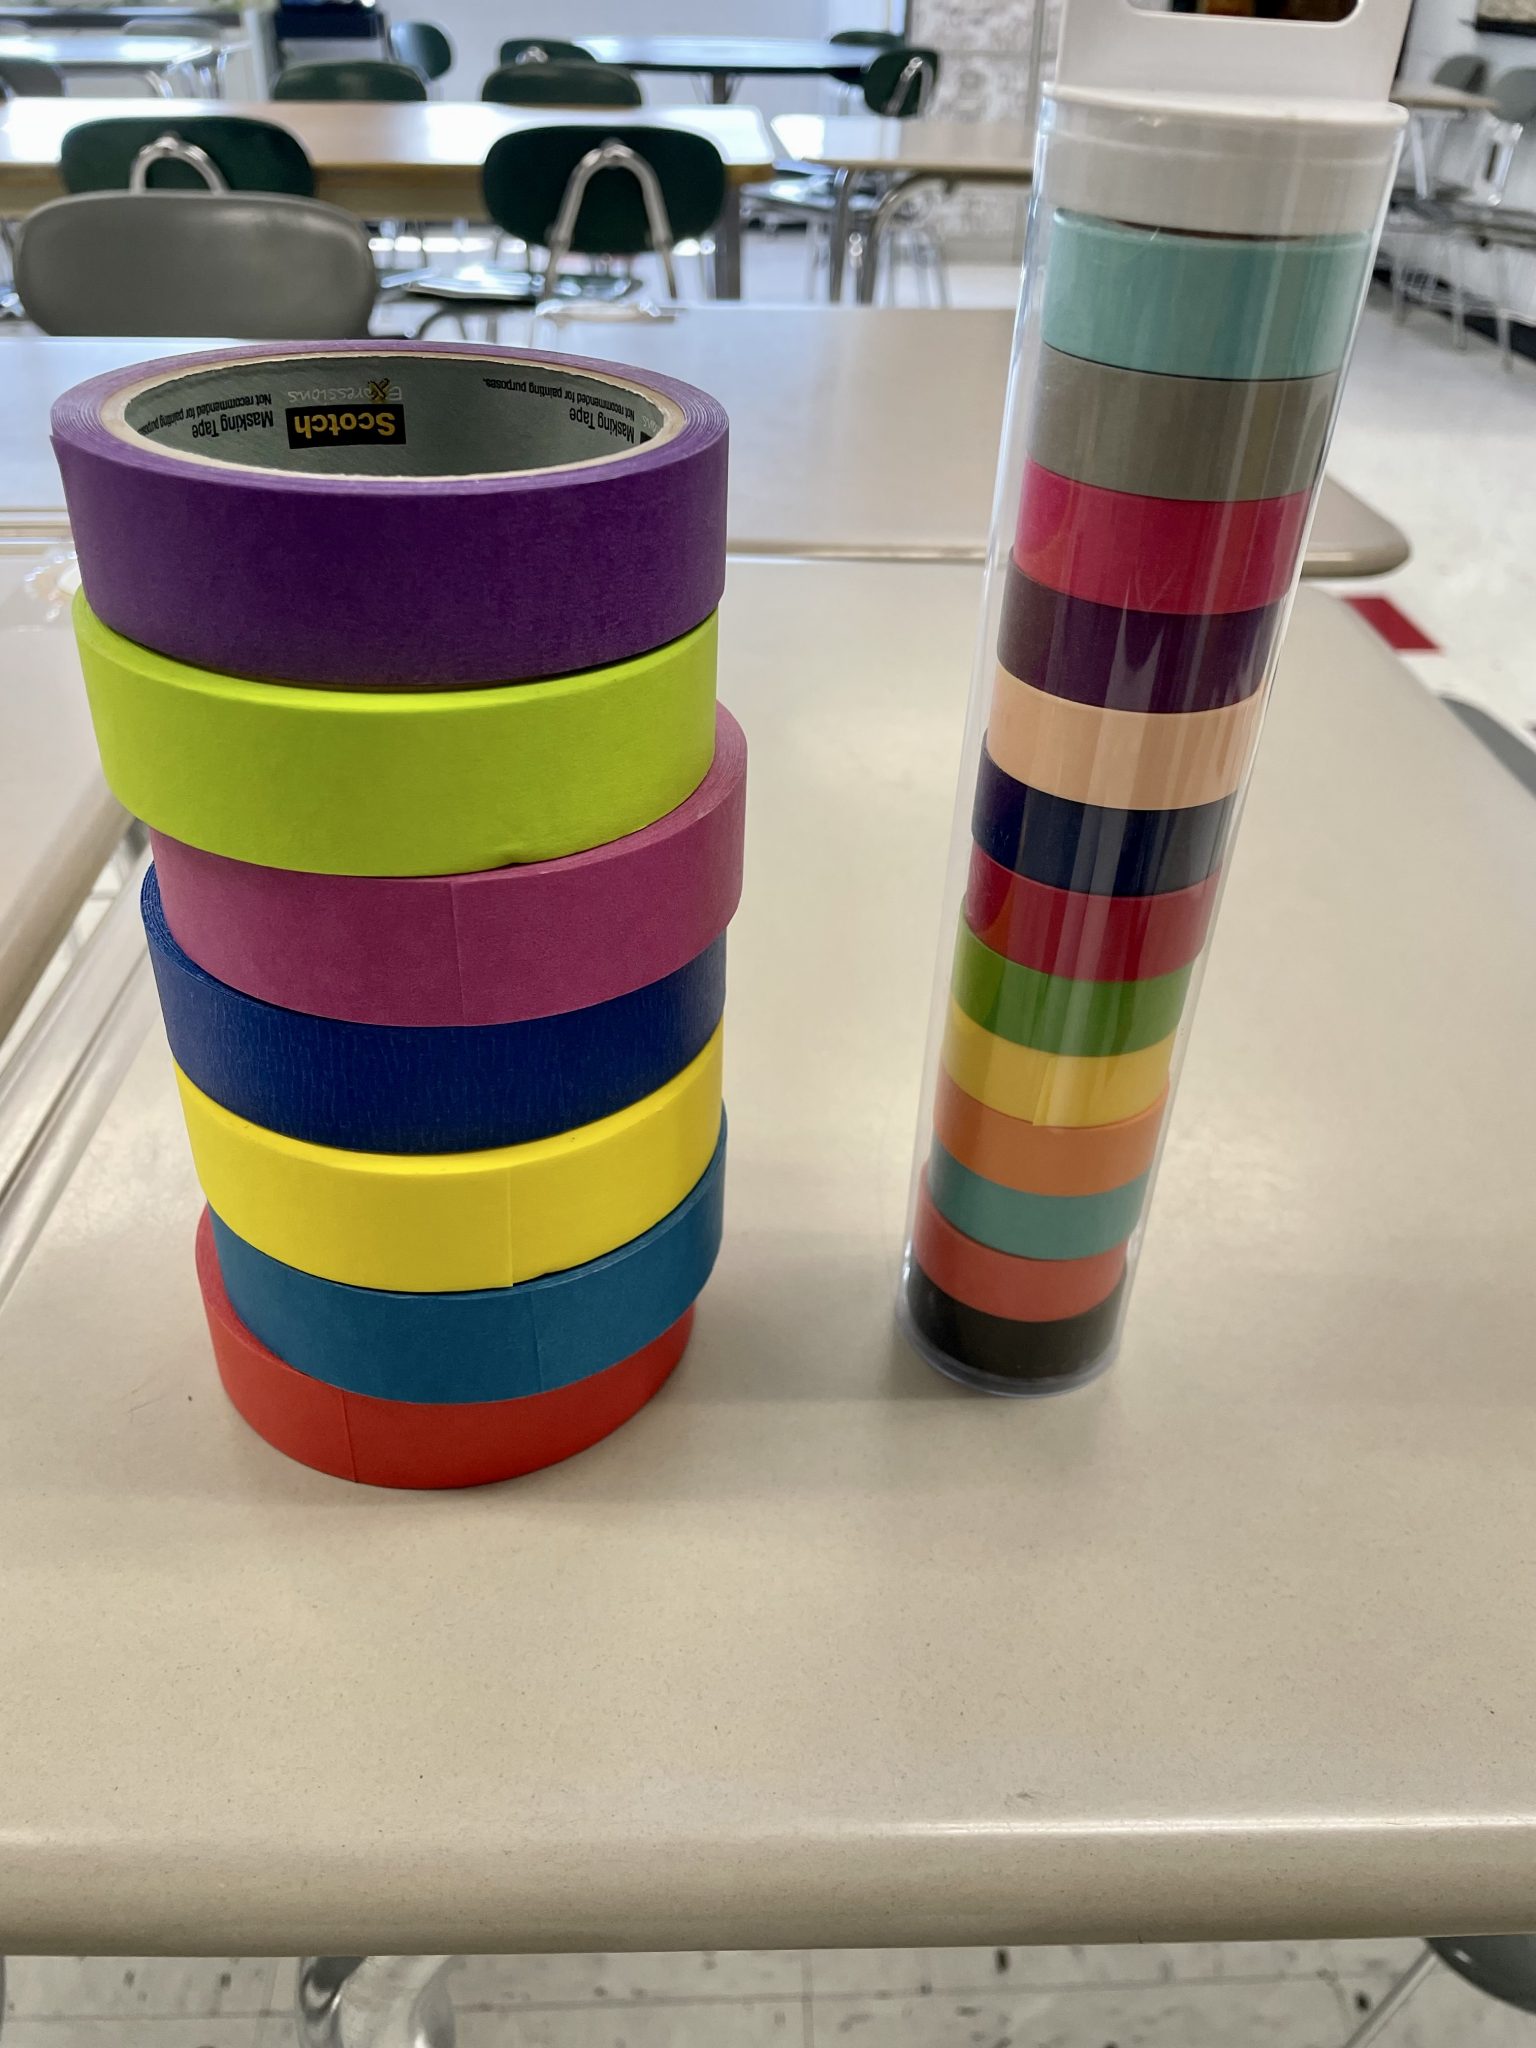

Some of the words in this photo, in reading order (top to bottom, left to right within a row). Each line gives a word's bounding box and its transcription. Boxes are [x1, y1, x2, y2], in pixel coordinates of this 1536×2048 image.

[482, 378, 527, 393] purposes.
[528, 382, 562, 399] painting
[196, 395, 254, 418] recommended
[256, 393, 272, 406] Not
[564, 390, 575, 404] for
[576, 393, 624, 416] recommended
[186, 407, 196, 420] for
[221, 410, 274, 432] Masking
[569, 407, 596, 430] Tape
[625, 406, 635, 422] Not
[191, 418, 219, 438] Tape
[293, 412, 396, 439] Scotch
[597, 411, 635, 444] Masking
